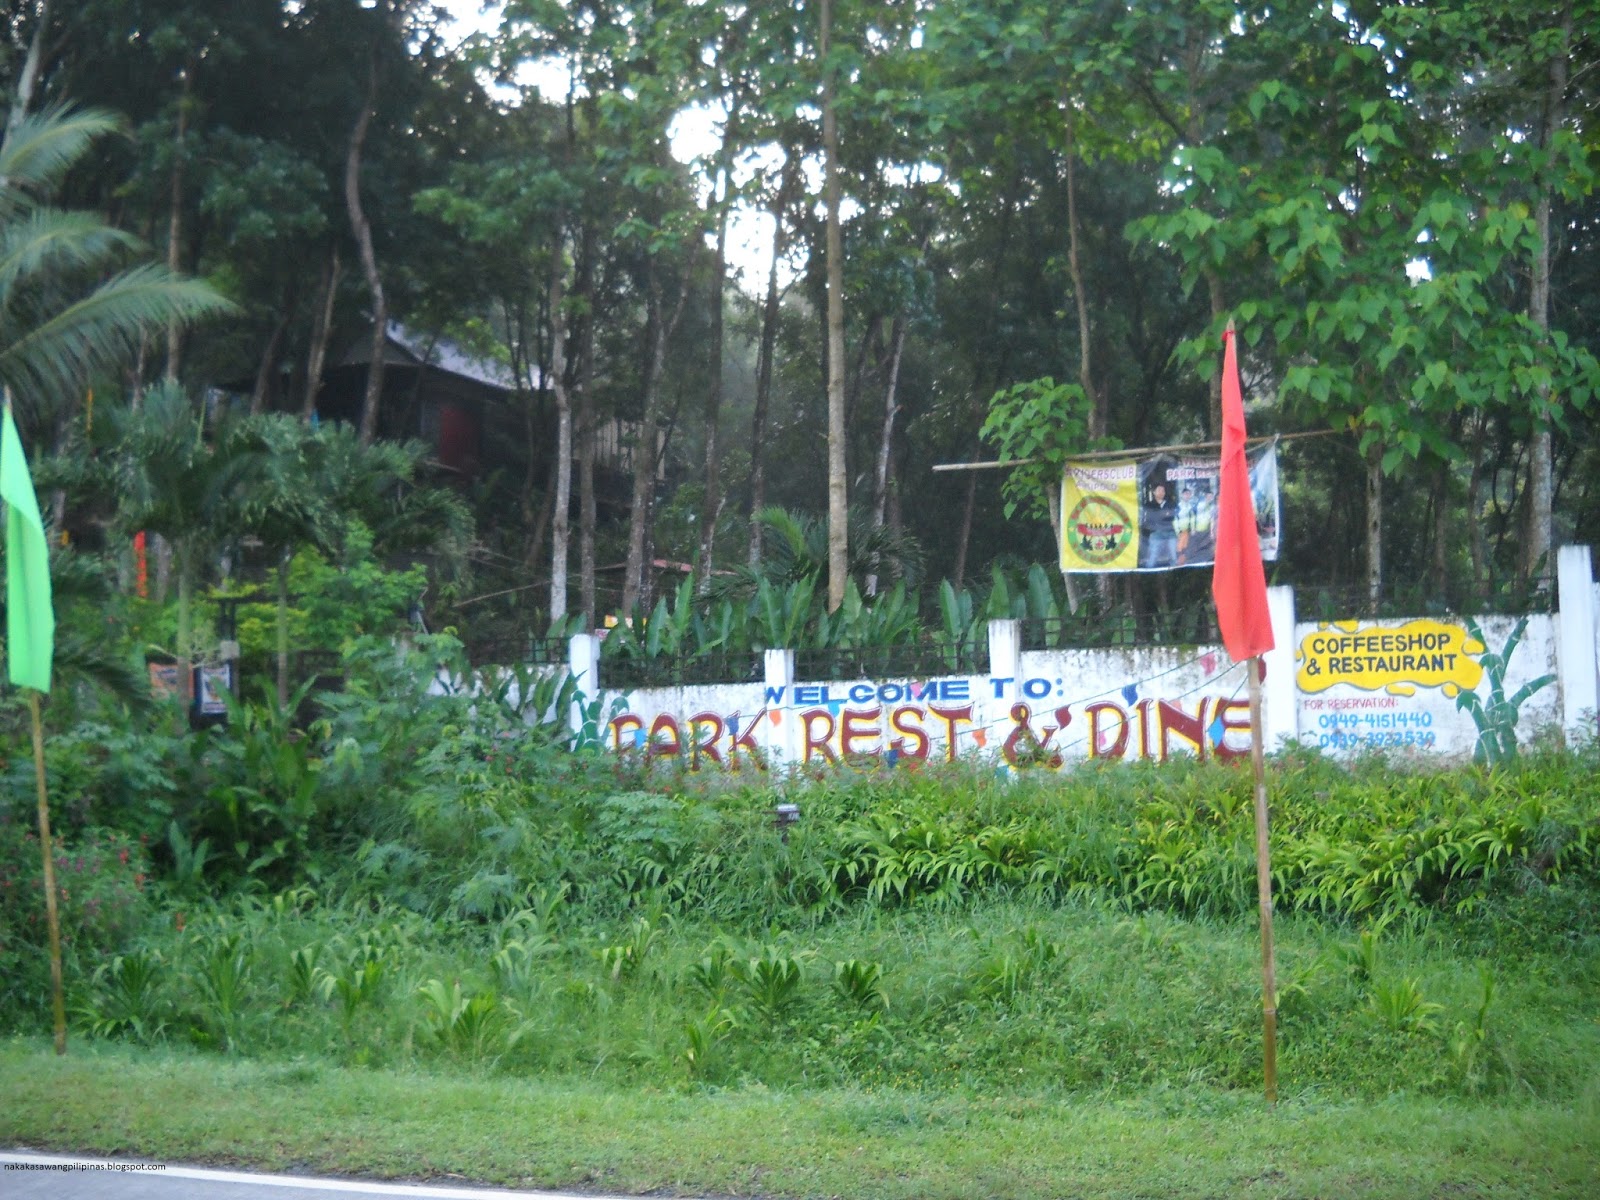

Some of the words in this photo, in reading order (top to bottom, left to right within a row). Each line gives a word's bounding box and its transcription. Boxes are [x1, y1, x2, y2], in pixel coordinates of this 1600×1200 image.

[1065, 464, 1134, 480] ERSCLUB
[1312, 633, 1451, 654] COFFEESHOP
[1306, 658, 1321, 675] &
[1329, 654, 1457, 674] RESTAURANT
[765, 679, 970, 705] WELCOME
[989, 677, 1064, 699] TO:
[1304, 699, 1323, 710] FOR
[1319, 711, 1433, 728] 0949-4151440
[608, 706, 768, 772] PARK
[800, 701, 975, 772] REST
[1002, 701, 1065, 771] &
[1084, 696, 1251, 763] DINE
